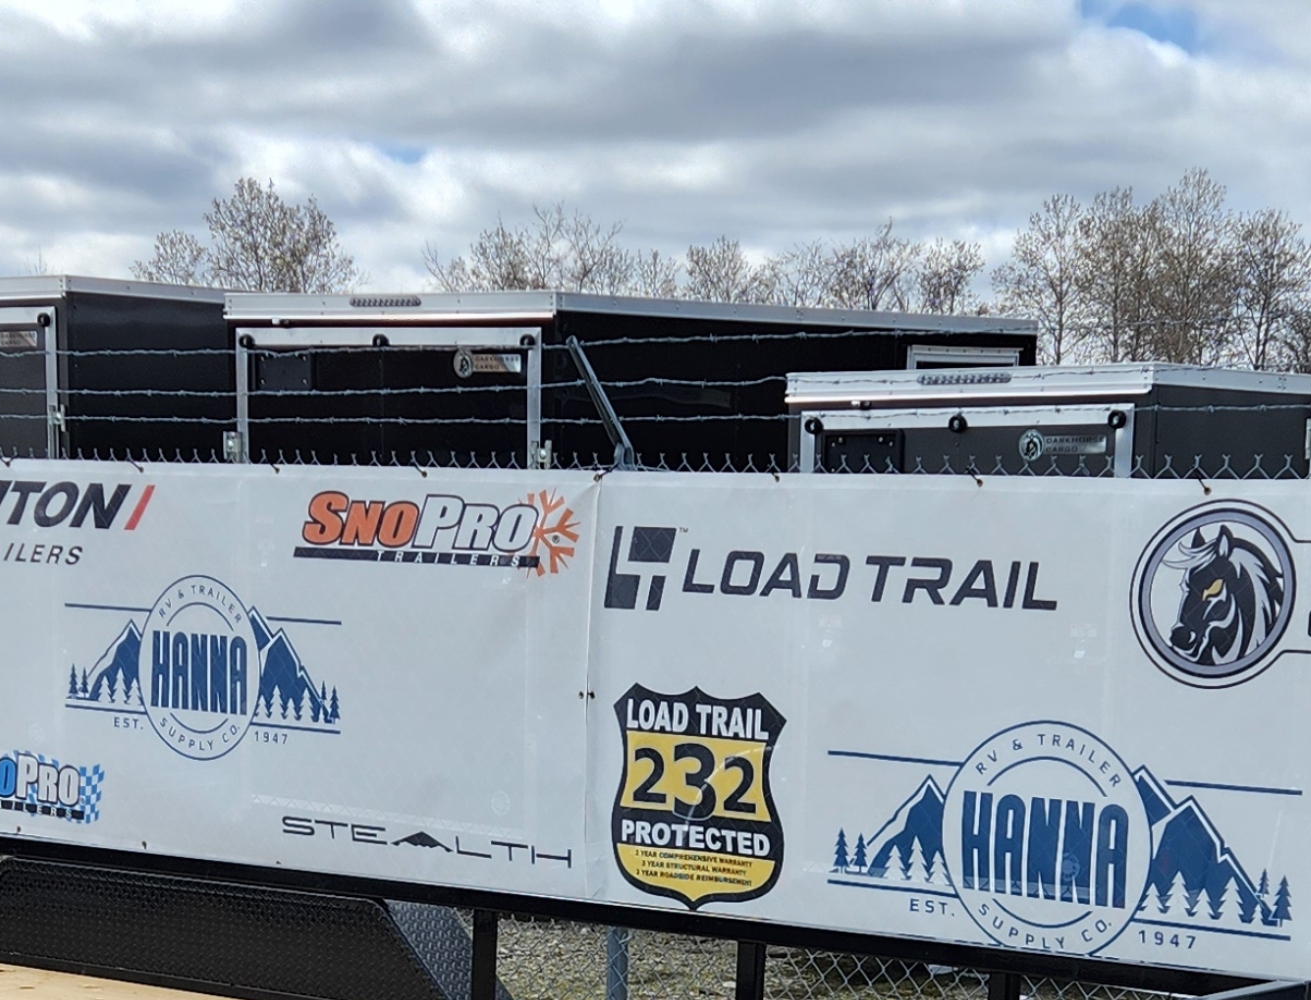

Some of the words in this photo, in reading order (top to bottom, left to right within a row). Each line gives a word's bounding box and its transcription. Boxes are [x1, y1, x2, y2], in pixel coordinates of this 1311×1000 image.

[377, 550, 520, 567] TRAILERS
[682, 548, 850, 600] LOAD
[865, 554, 1058, 611] TRAIL
[158, 598, 172, 619] RV
[190, 584, 242, 623] TRAILER
[150, 630, 247, 716] HANNA
[113, 717, 144, 730] EST.
[159, 717, 214, 751] SUPPLY
[222, 724, 241, 744] CO.
[254, 731, 289, 745] 1947
[626, 698, 689, 733] LOAD
[695, 703, 769, 741] TRAIL
[975, 750, 998, 775] RV
[1012, 738, 1023, 751] &
[1037, 733, 1122, 788] TRAILER
[632, 742, 757, 821] 232
[282, 815, 572, 869] STEALTH
[621, 819, 771, 857] PROTECTED
[961, 790, 1129, 909] HANNA
[640, 850, 657, 858] YEAR
[659, 851, 717, 863] COMPREHENSIVE
[718, 857, 753, 868] WARRANTY
[647, 860, 665, 869] YEAR
[666, 862, 710, 872] STRUCTURAL
[712, 866, 746, 876] WARRANTY
[660, 871, 695, 881] ROADSIDE
[696, 873, 752, 887] REIMBURSEMENT
[909, 898, 955, 917] EST.
[978, 902, 1065, 949] SUPPLY
[1081, 920, 1112, 943] CO.
[1138, 929, 1197, 950] 1947
